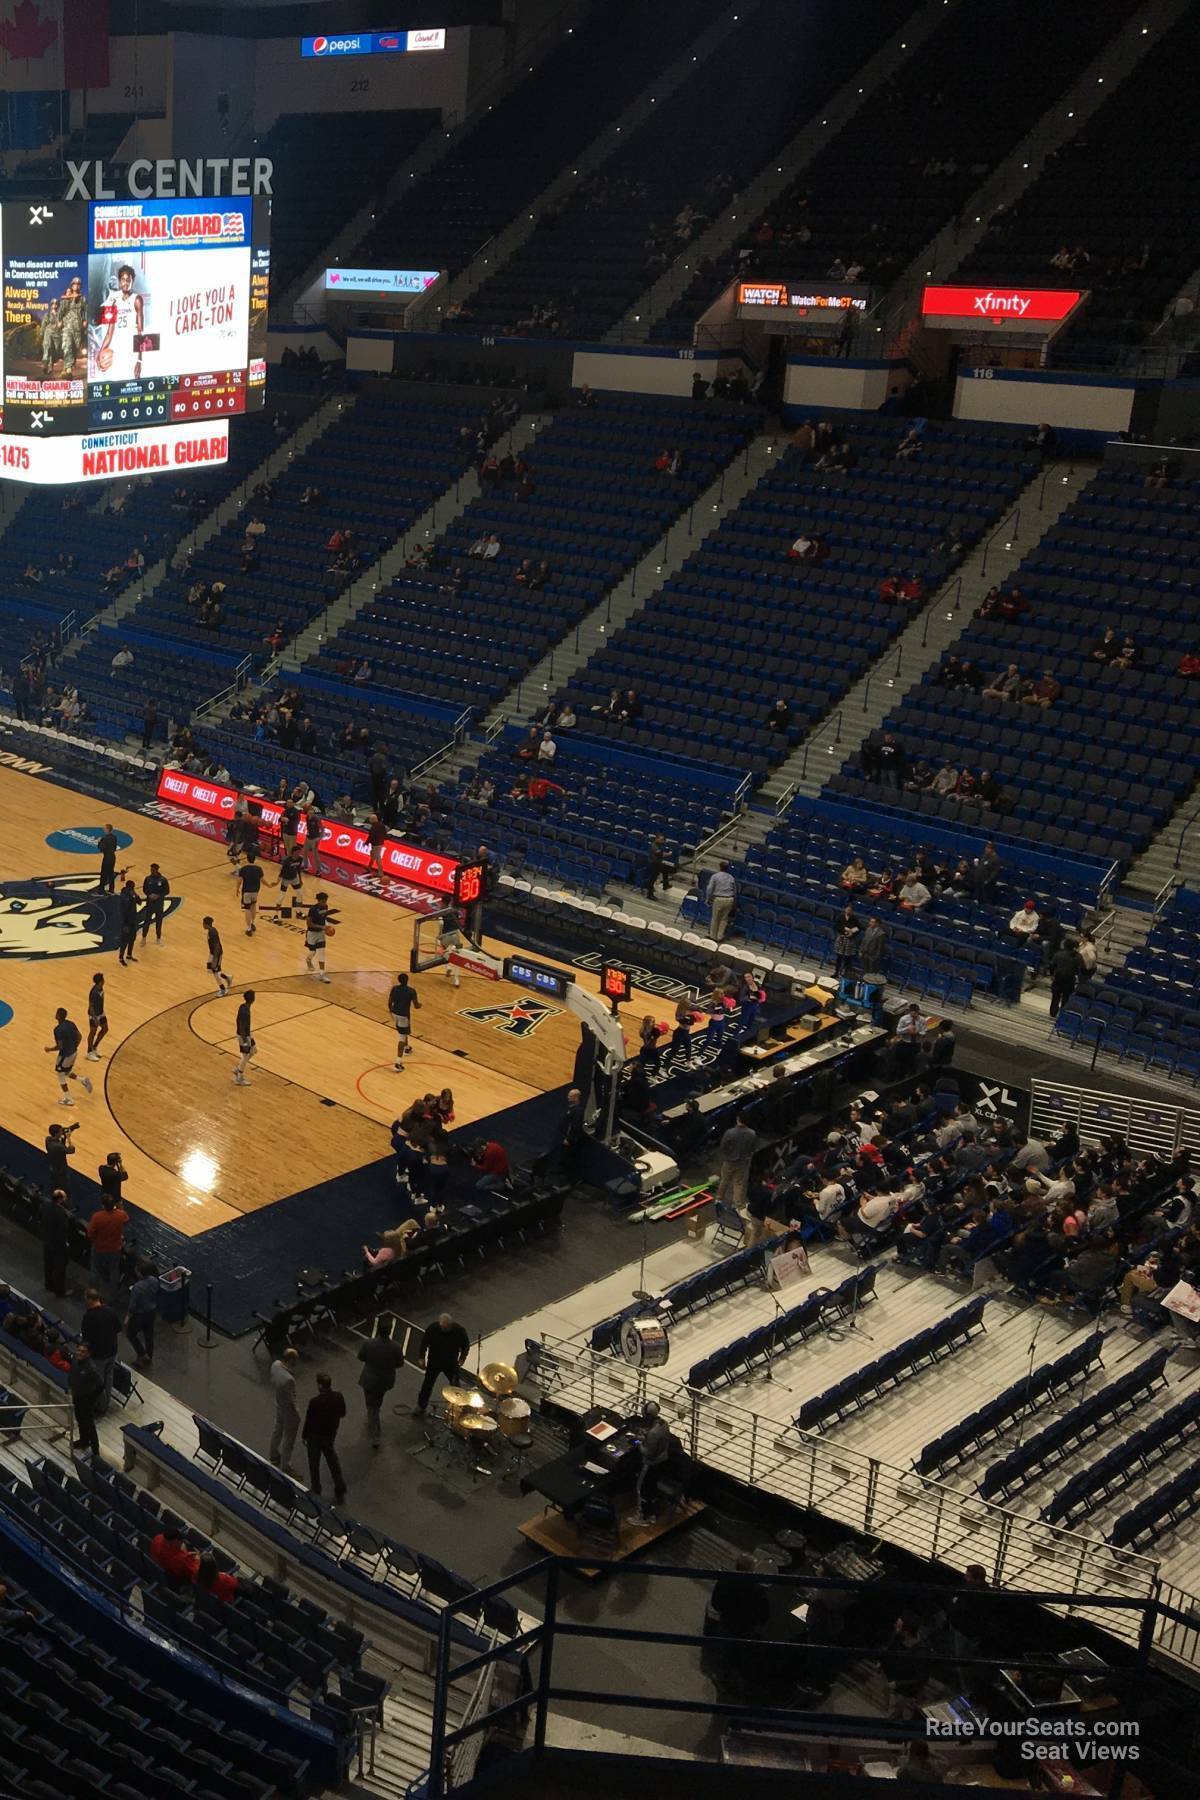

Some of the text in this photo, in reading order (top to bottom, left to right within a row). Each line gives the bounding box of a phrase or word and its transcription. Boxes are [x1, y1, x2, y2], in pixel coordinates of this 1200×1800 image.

[329, 38, 360, 52] pepsi
[351, 80, 369, 92] 212
[64, 158, 273, 200] XL CENTER
[95, 215, 222, 240] NATIONAL GUARD
[9, 260, 78, 268] When disaster strikes
[4, 269, 59, 279] in Connecticut
[5, 286, 39, 300] Always
[177, 293, 201, 313] LOVE
[206, 288, 226, 308] YOU
[229, 285, 235, 301] A
[745, 289, 780, 298] WATCH
[974, 293, 1031, 315] xfinity
[5, 311, 31, 323] There
[117, 316, 128, 329] 25
[175, 302, 233, 336] CARL-TON
[678, 350, 695, 359] 115
[972, 368, 994, 379] 116
[6, 380, 71, 391] NATIONAL GUARD
[148, 381, 154, 391] 0
[184, 378, 191, 387] 0
[120, 386, 142, 394] HUSKIES
[193, 401, 199, 410] 0
[205, 400, 211, 409] 0
[217, 399, 223, 408] 0
[228, 398, 235, 406] 0
[120, 409, 127, 418] 0
[133, 408, 139, 417] 0
[146, 407, 152, 415] 0
[158, 405, 164, 414] 0
[81, 433, 139, 450] CONNECTICUT
[83, 442, 171, 476] NATIONAL
[192, 785, 218, 804] CHEEZ-IT
[144, 801, 217, 827] UCONN
[391, 850, 424, 872] CHEEZ-IT
[352, 881, 418, 905] HEALTH
[459, 880, 480, 902] 30
[511, 964, 556, 986] CBS CBS
[608, 981, 624, 996] 30
[976, 1082, 1018, 1112] XL
